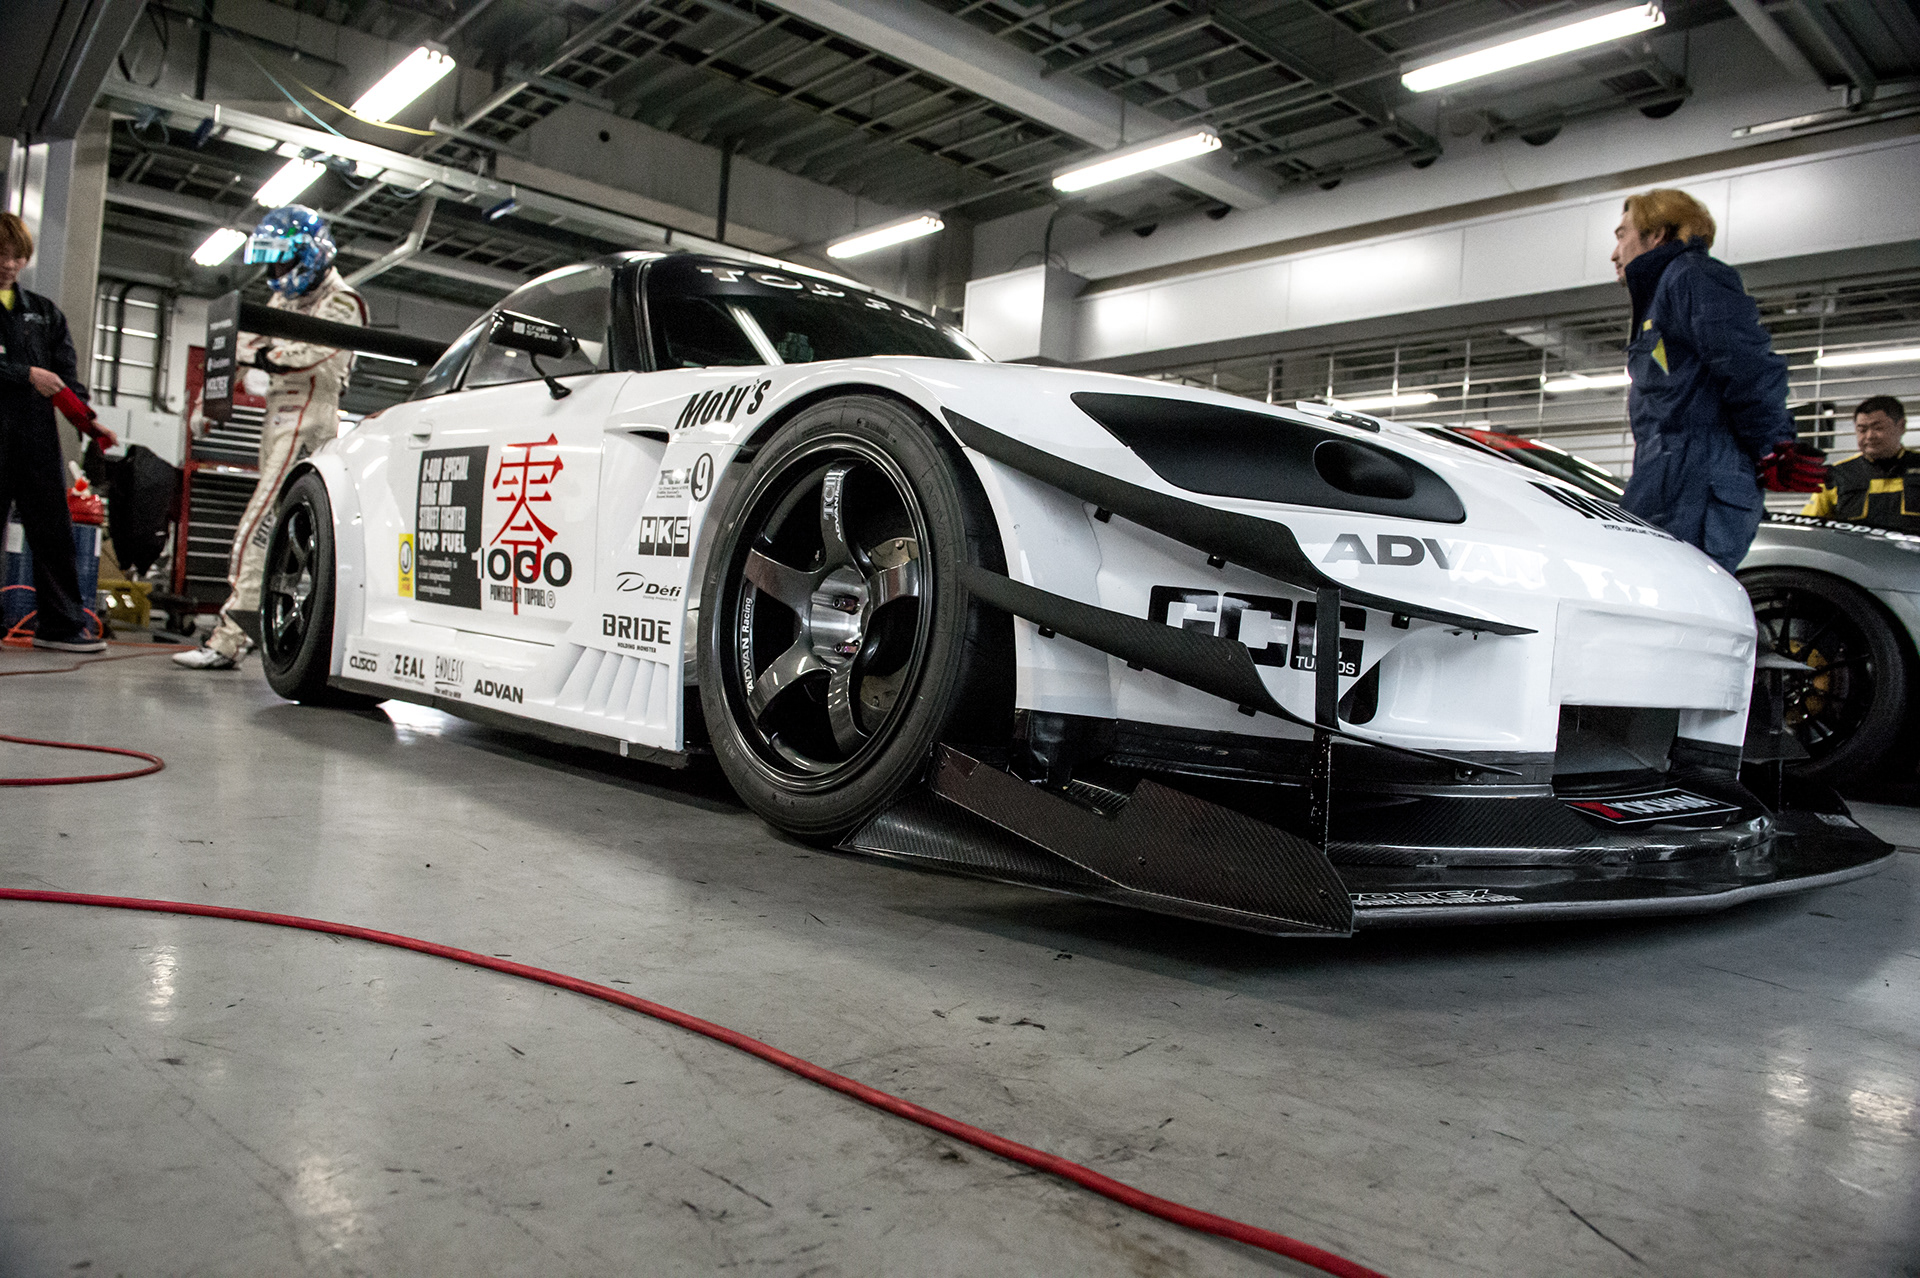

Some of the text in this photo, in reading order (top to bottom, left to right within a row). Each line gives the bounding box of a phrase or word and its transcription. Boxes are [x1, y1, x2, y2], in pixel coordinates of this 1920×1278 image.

[418, 531, 467, 554] TOP FUEL
[640, 519, 690, 545] HKS
[645, 583, 682, 597] Défi
[742, 597, 754, 633] Racing
[602, 613, 671, 645] BRIDE
[349, 656, 377, 672] CUSCO
[394, 654, 425, 679] ZEAL
[435, 656, 464, 682] ENDLESS
[1296, 655, 1356, 675] TUOS
[474, 679, 523, 704] ADVAN
